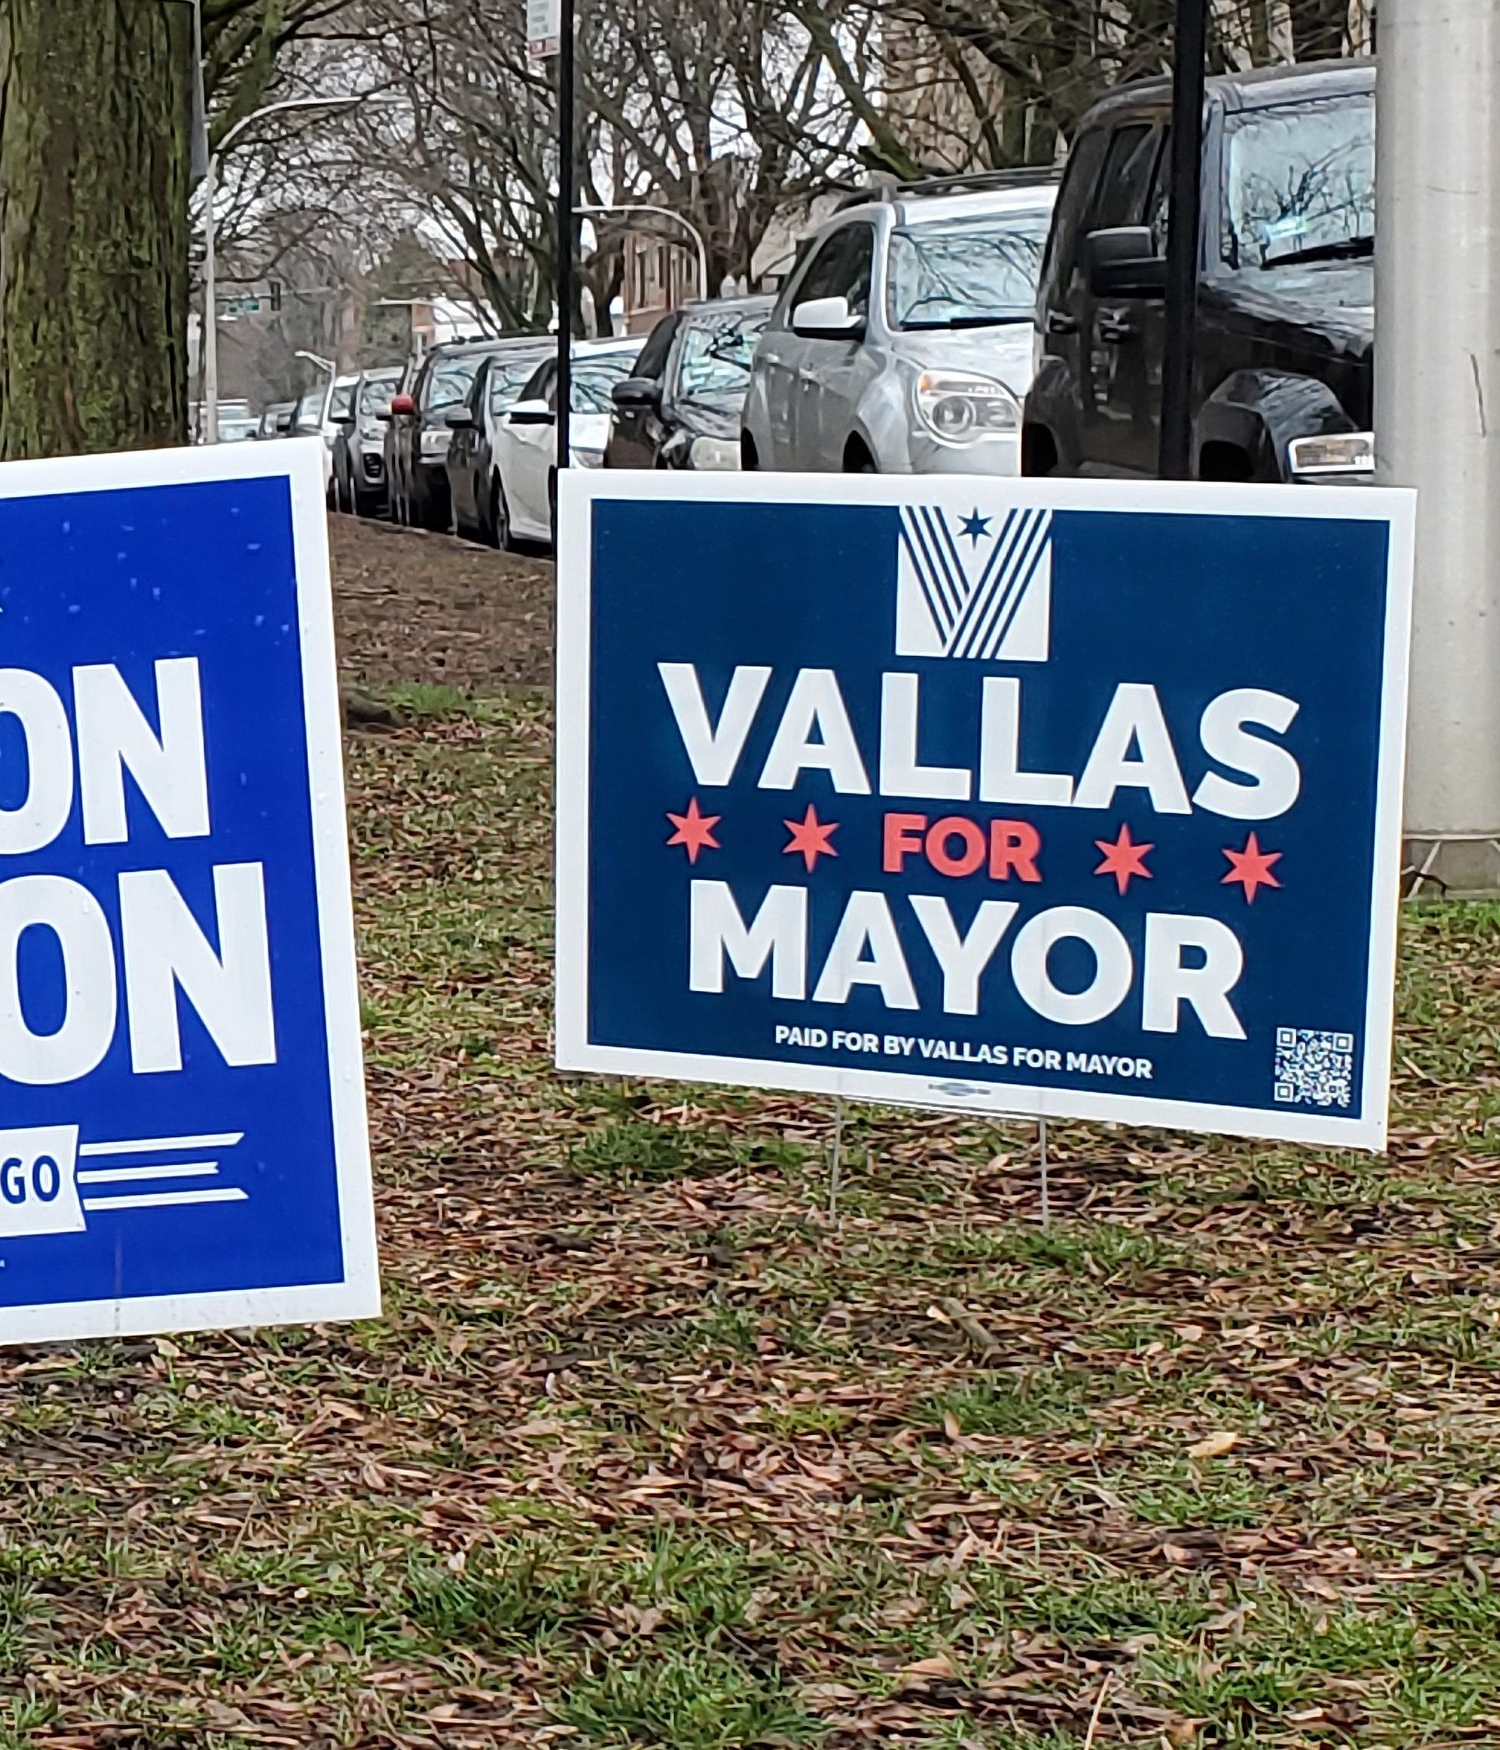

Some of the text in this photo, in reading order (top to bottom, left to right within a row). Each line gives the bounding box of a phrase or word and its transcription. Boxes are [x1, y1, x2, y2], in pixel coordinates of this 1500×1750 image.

[657, 662, 1301, 820] VALLAS
[883, 813, 1042, 883] FOR
[689, 879, 1248, 1040] MAYOR
[775, 1024, 1153, 1079] PAID FOR BY VALLAS FOR MAYOR
